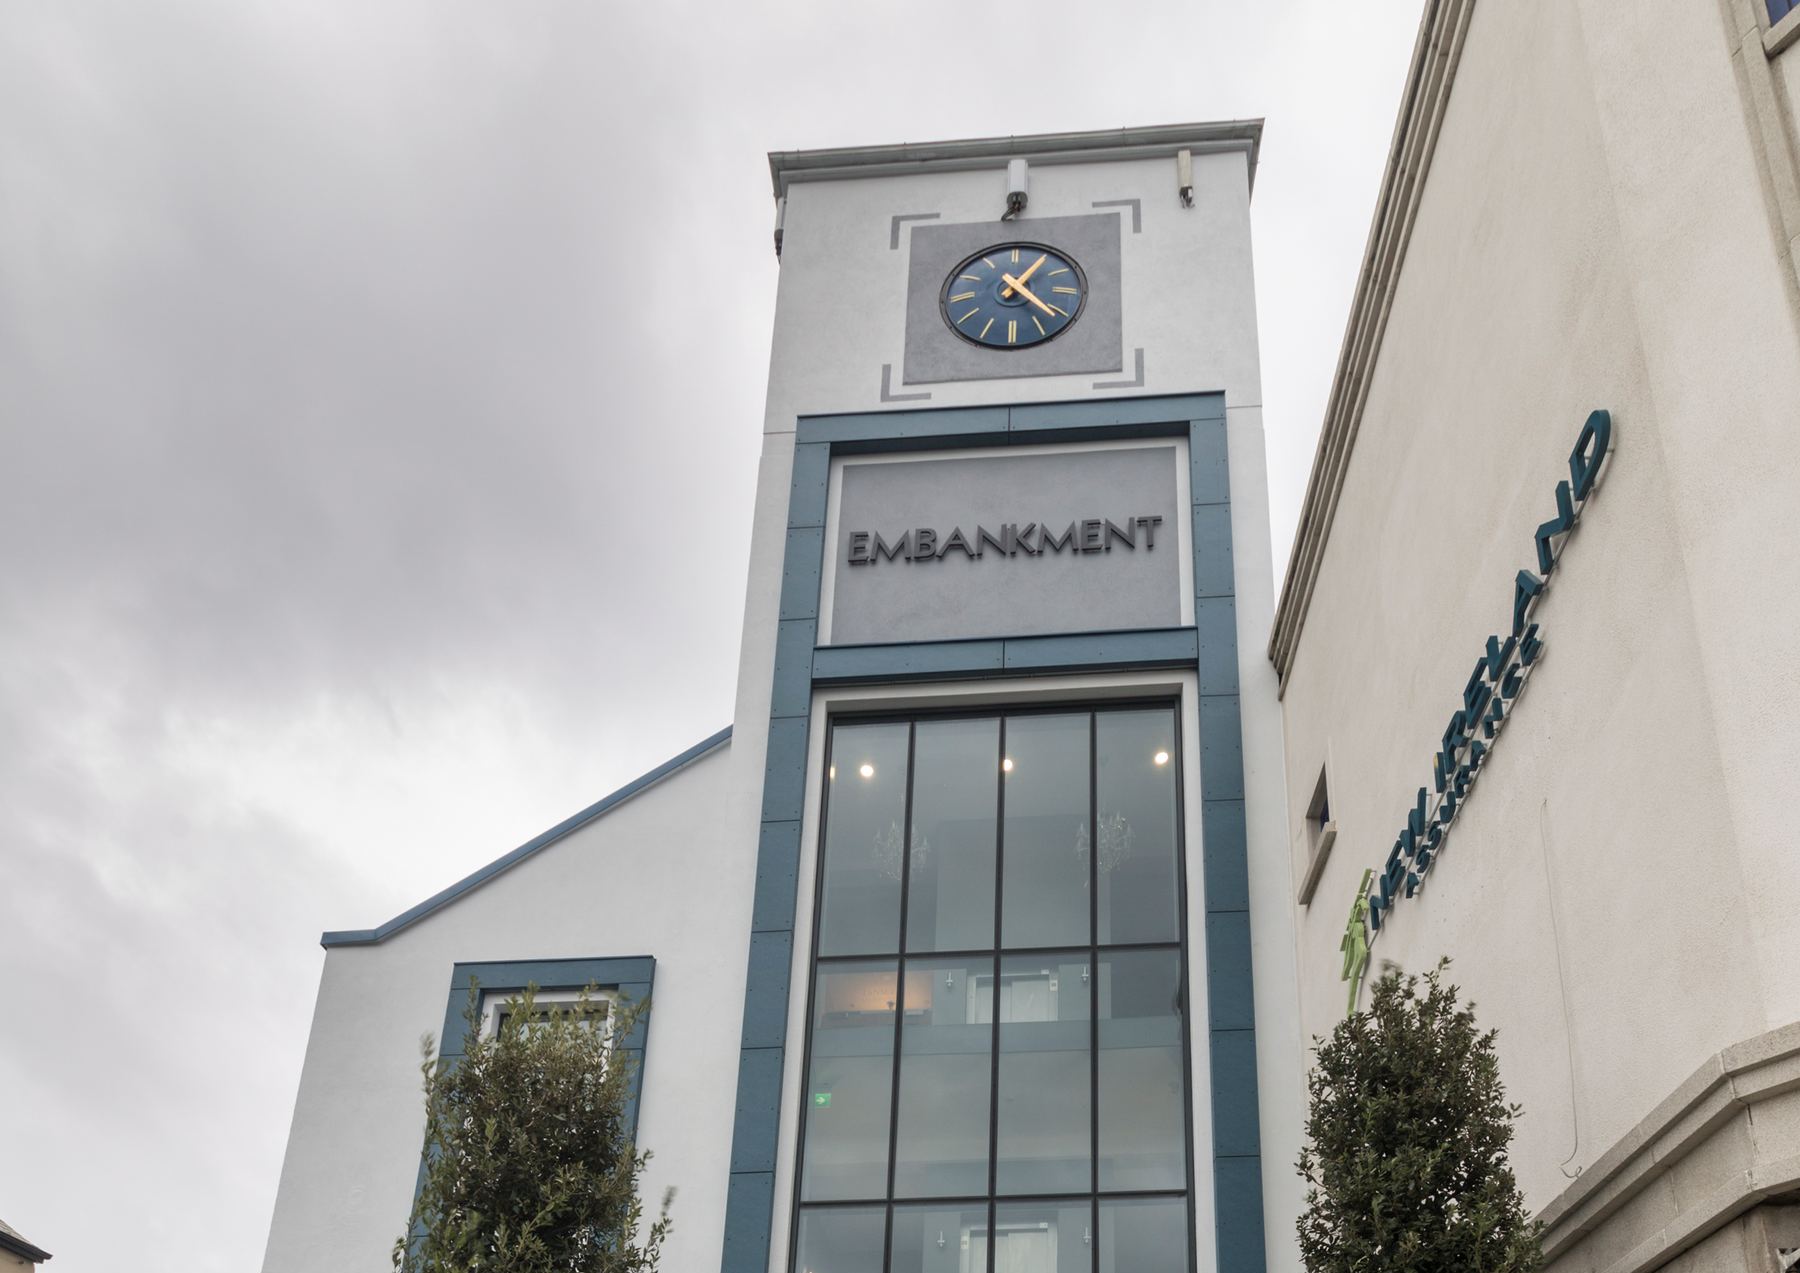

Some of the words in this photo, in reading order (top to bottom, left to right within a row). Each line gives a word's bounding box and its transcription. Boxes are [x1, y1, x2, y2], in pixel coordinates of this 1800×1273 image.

[848, 515, 1163, 564] EMBANKMENT
[1369, 787, 1427, 931] NEW
[1433, 409, 1612, 794] IRELAND
